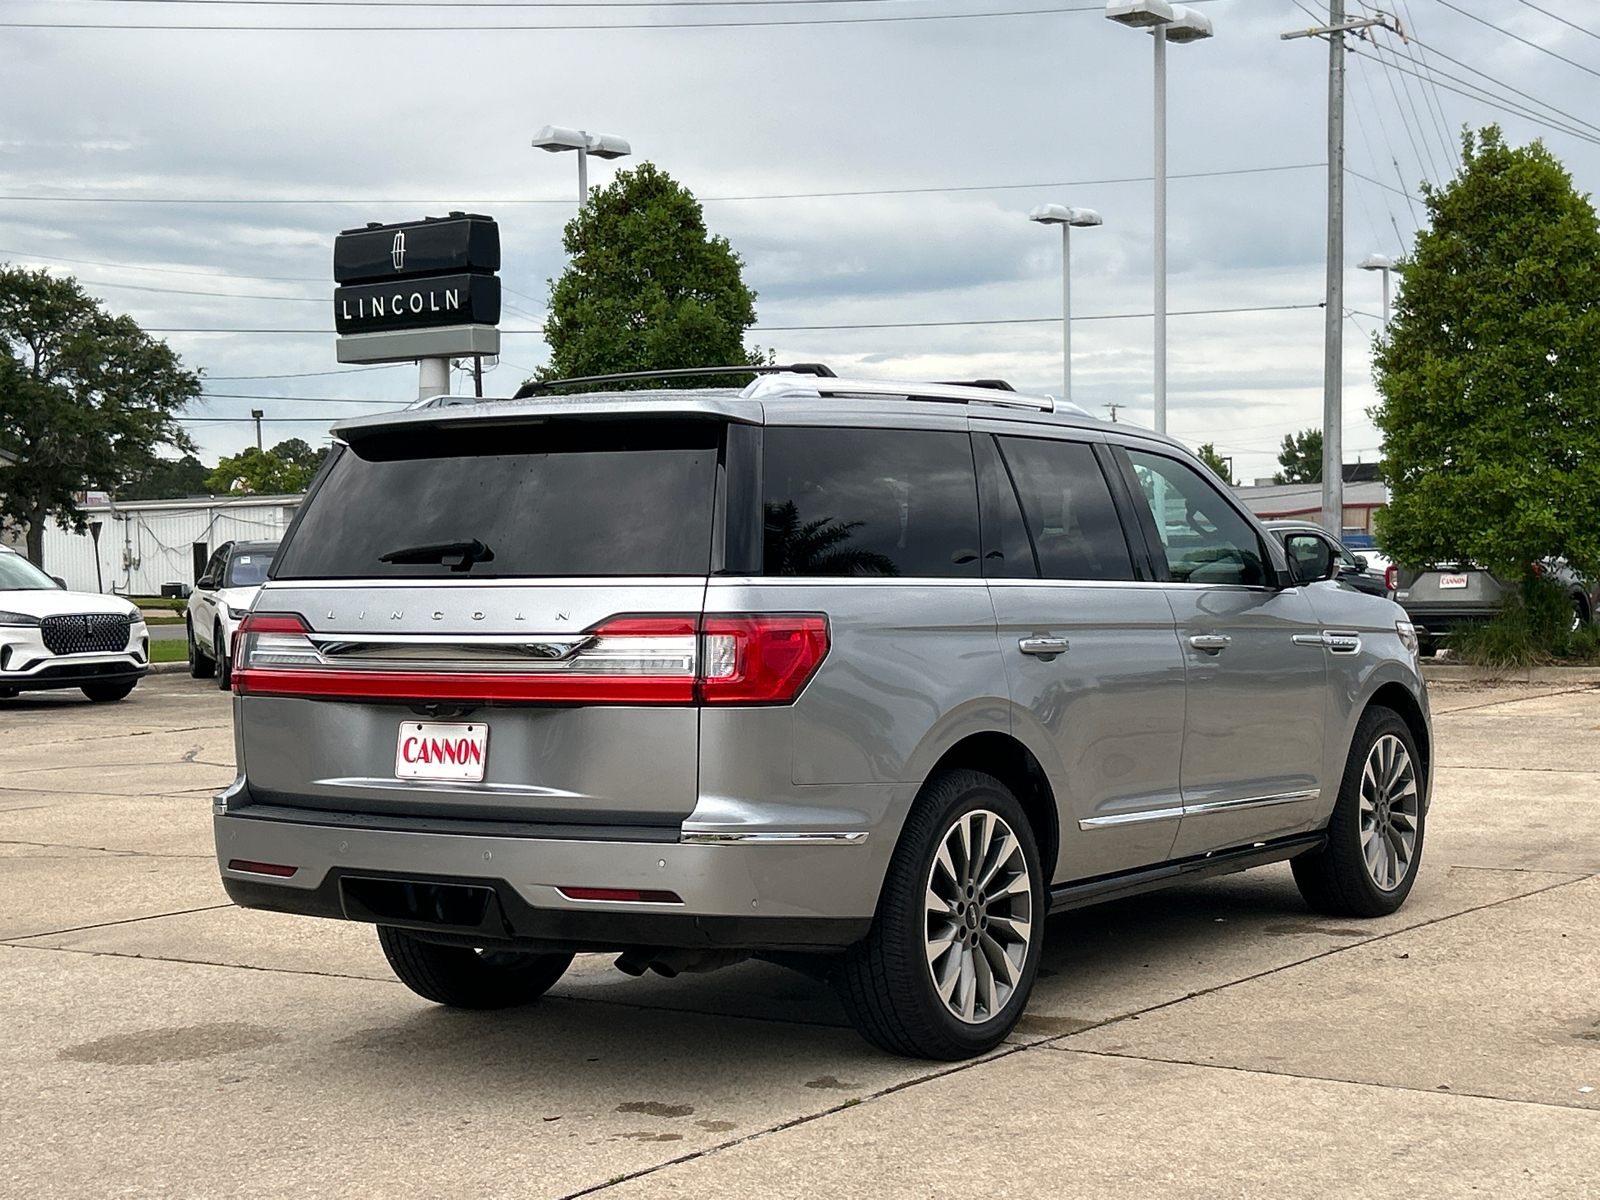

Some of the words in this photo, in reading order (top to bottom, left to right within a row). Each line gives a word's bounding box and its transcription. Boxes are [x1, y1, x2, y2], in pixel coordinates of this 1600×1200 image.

[343, 288, 459, 320] LINCOLN
[1441, 577, 1466, 585] CANNON
[327, 610, 571, 621] LINCOLN
[403, 736, 482, 765] CANNON
